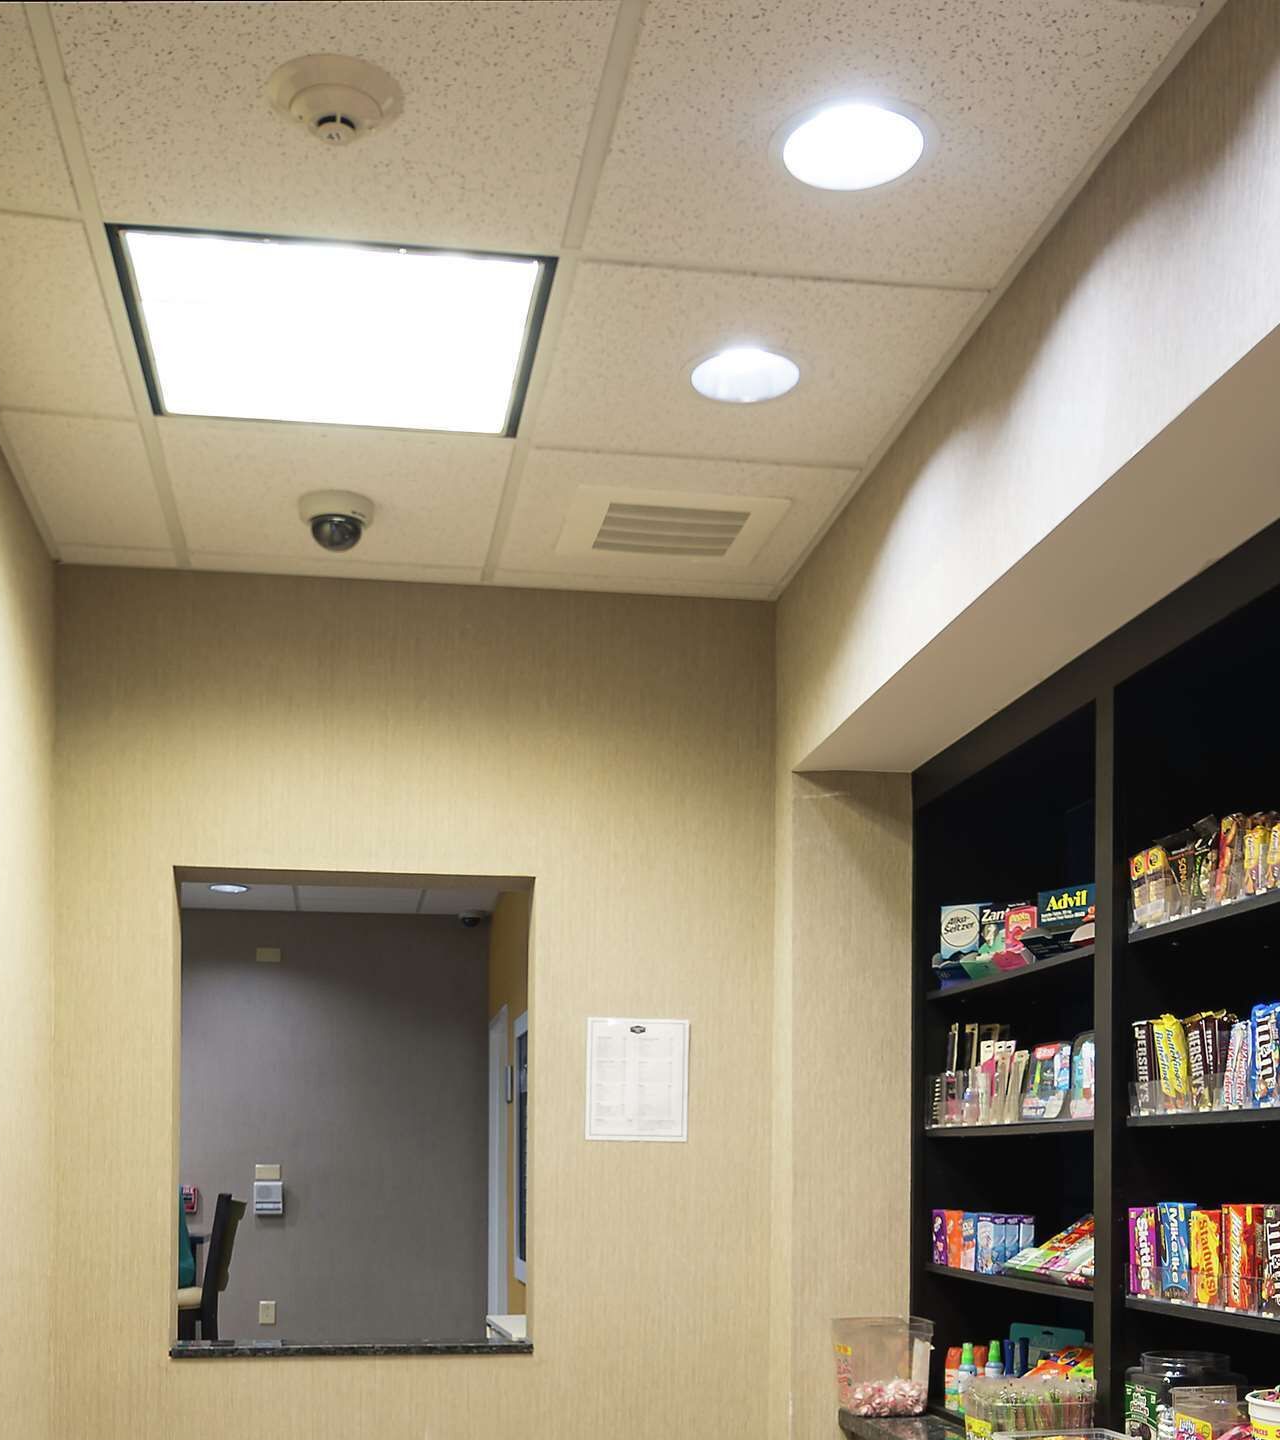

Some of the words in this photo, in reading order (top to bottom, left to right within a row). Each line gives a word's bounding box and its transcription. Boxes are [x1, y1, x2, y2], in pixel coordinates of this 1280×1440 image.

[1046, 890, 1087, 912] Advil
[1135, 1217, 1150, 1291] Skittles
[1179, 1419, 1196, 1436] Laffy
